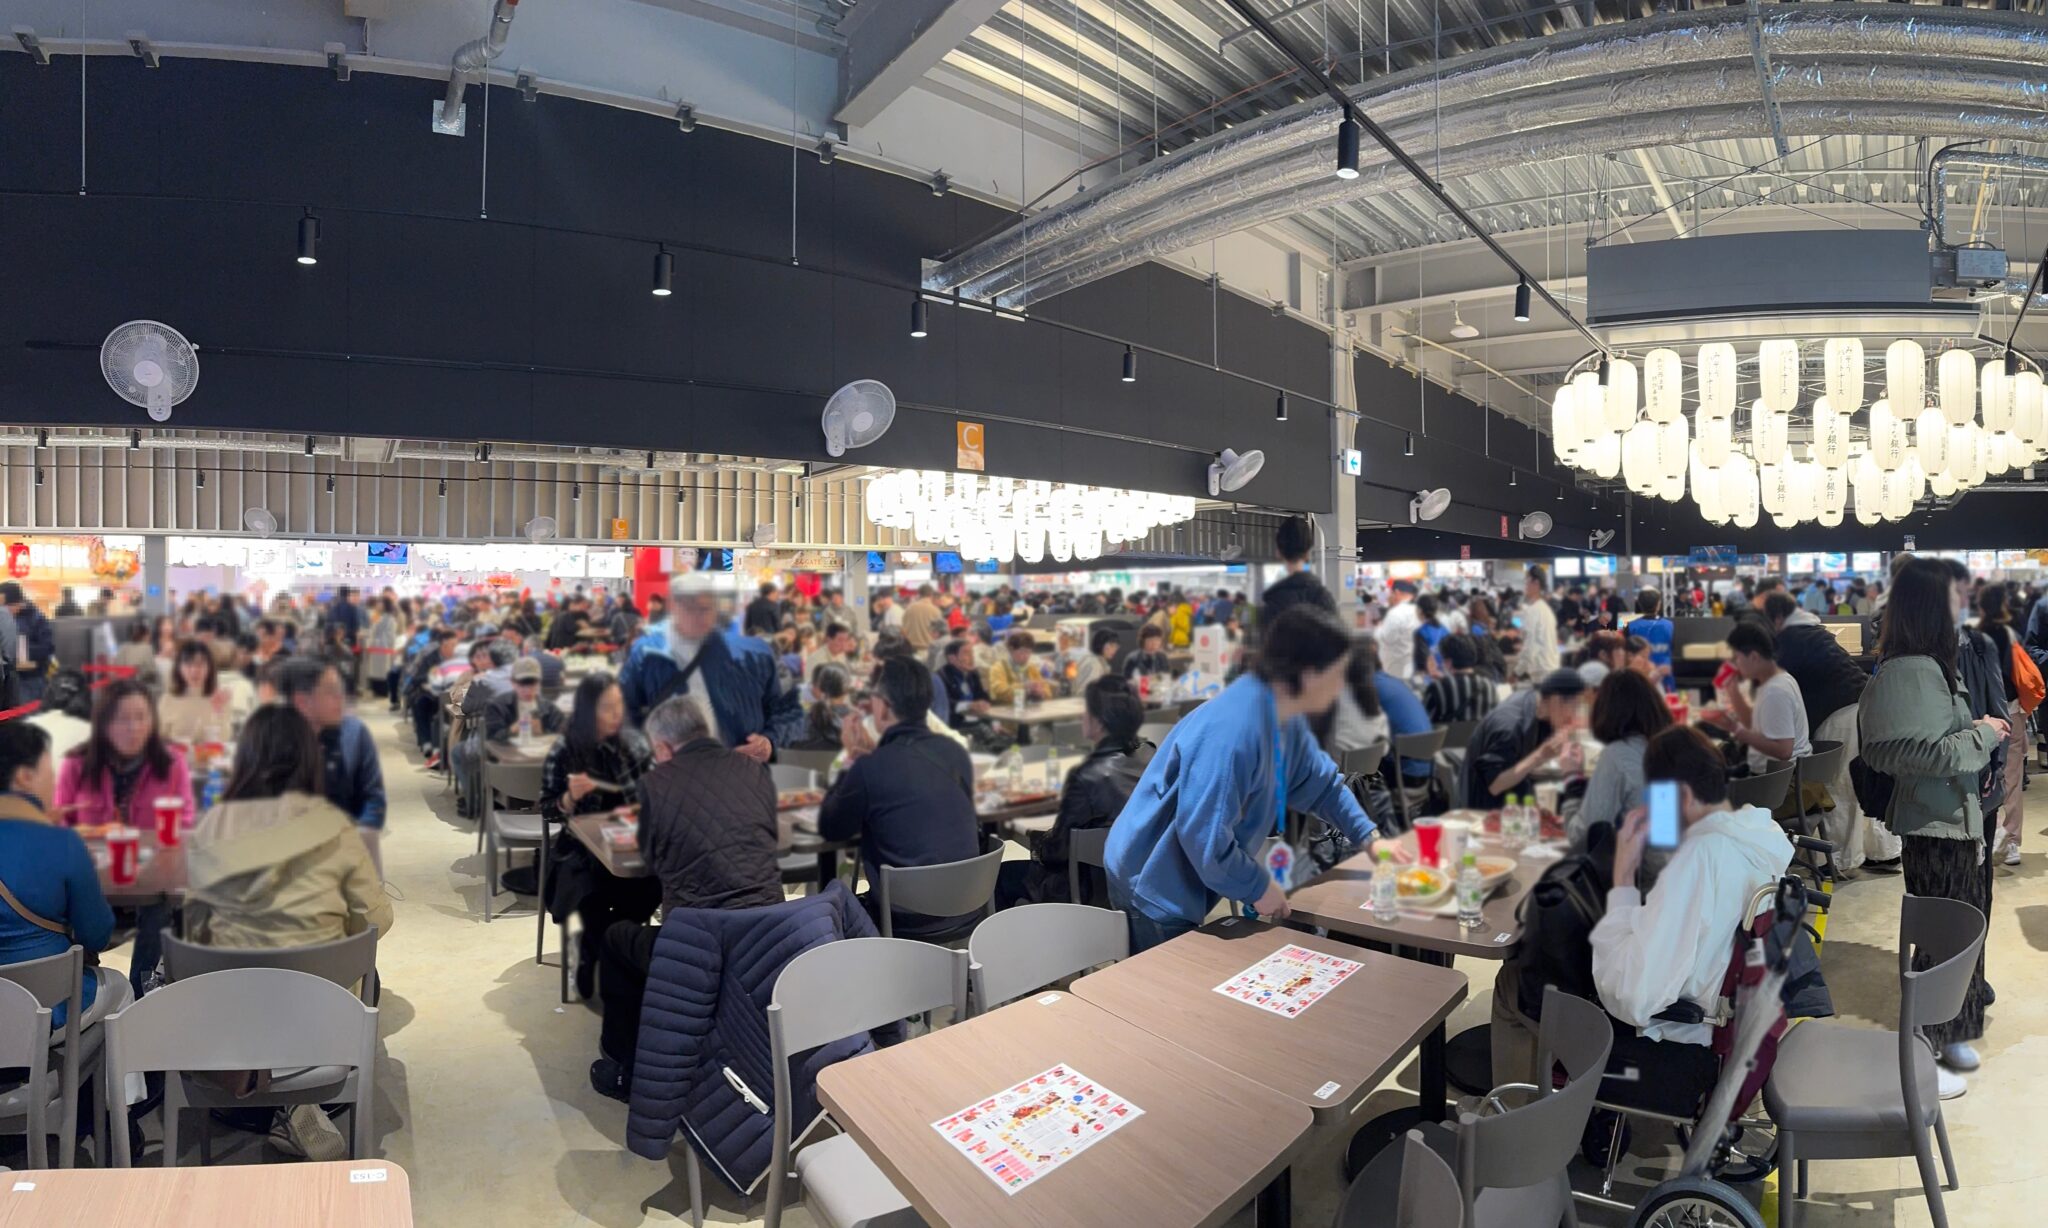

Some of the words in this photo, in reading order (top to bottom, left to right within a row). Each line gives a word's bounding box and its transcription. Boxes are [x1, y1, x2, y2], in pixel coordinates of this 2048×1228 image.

[963, 426, 979, 450] C
[1827, 411, 1837, 456] そな銀行
[616, 519, 626, 531] C
